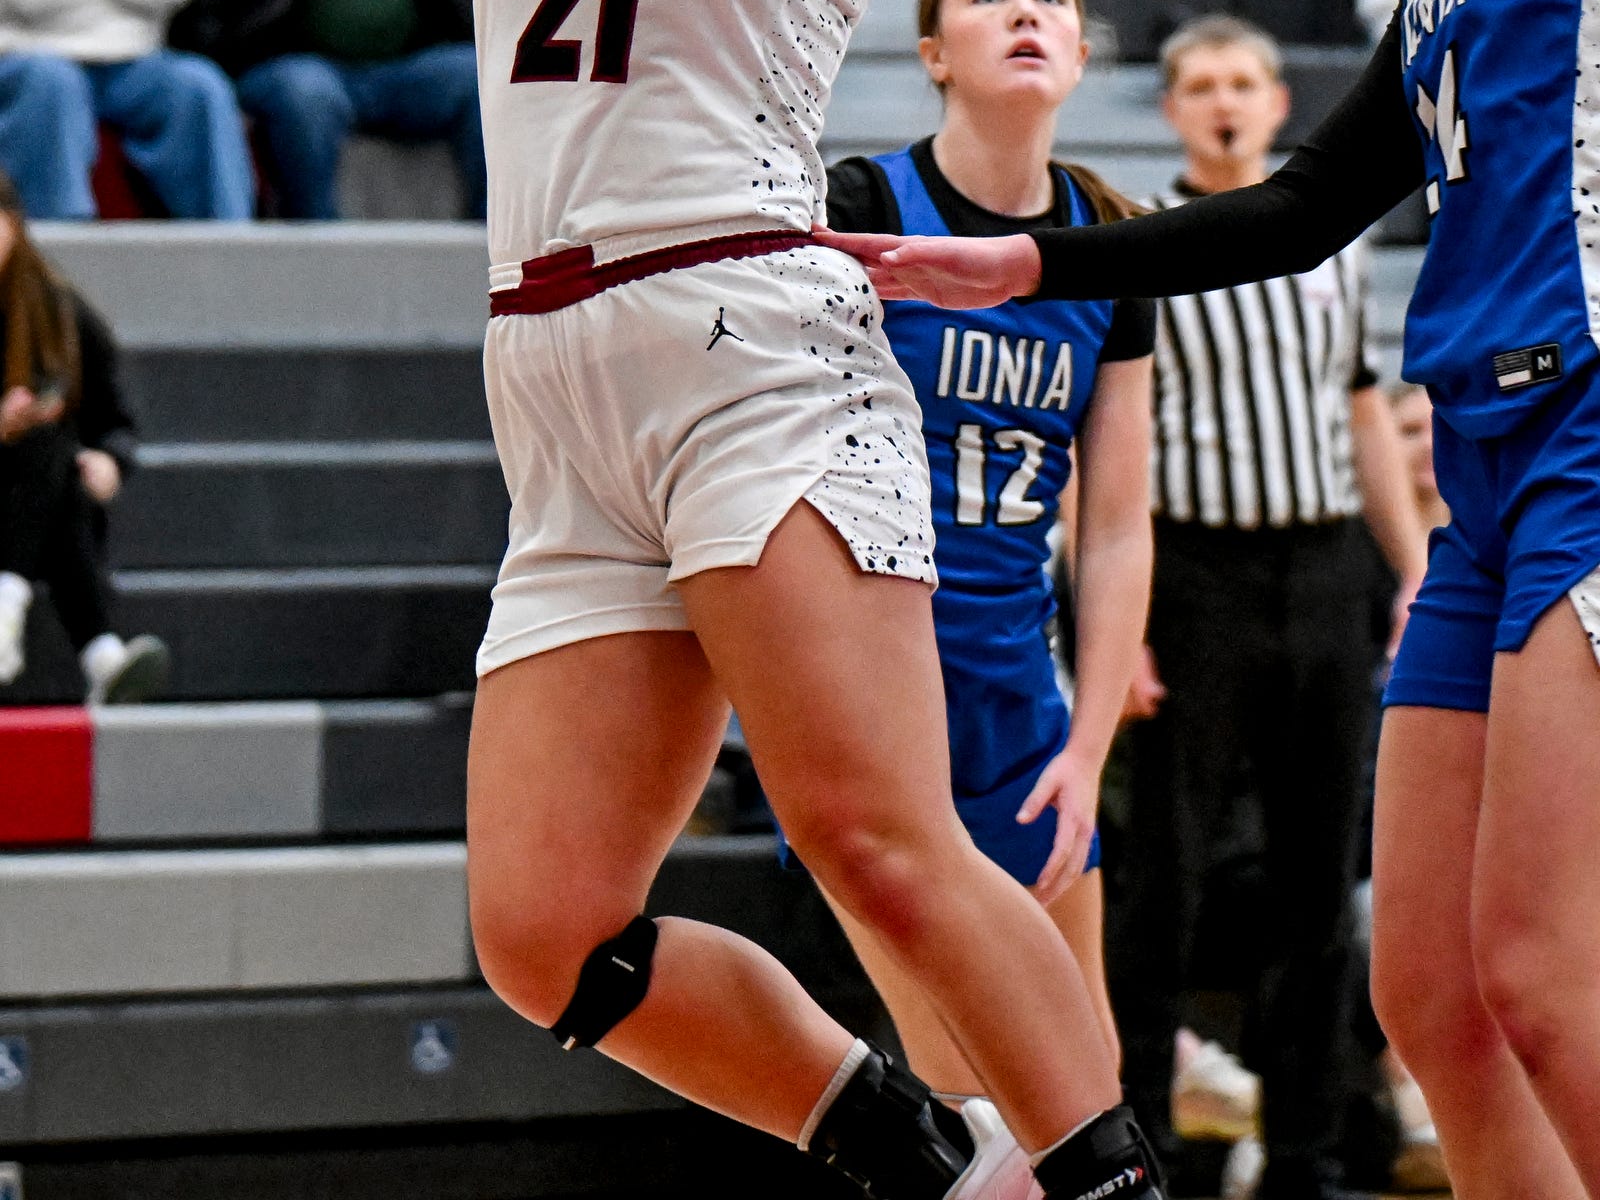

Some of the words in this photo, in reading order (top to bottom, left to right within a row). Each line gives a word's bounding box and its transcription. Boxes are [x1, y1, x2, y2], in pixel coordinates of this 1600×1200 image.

[937, 327, 1073, 411] IONIA
[1537, 354, 1553, 371] M
[955, 424, 1046, 524] 12
